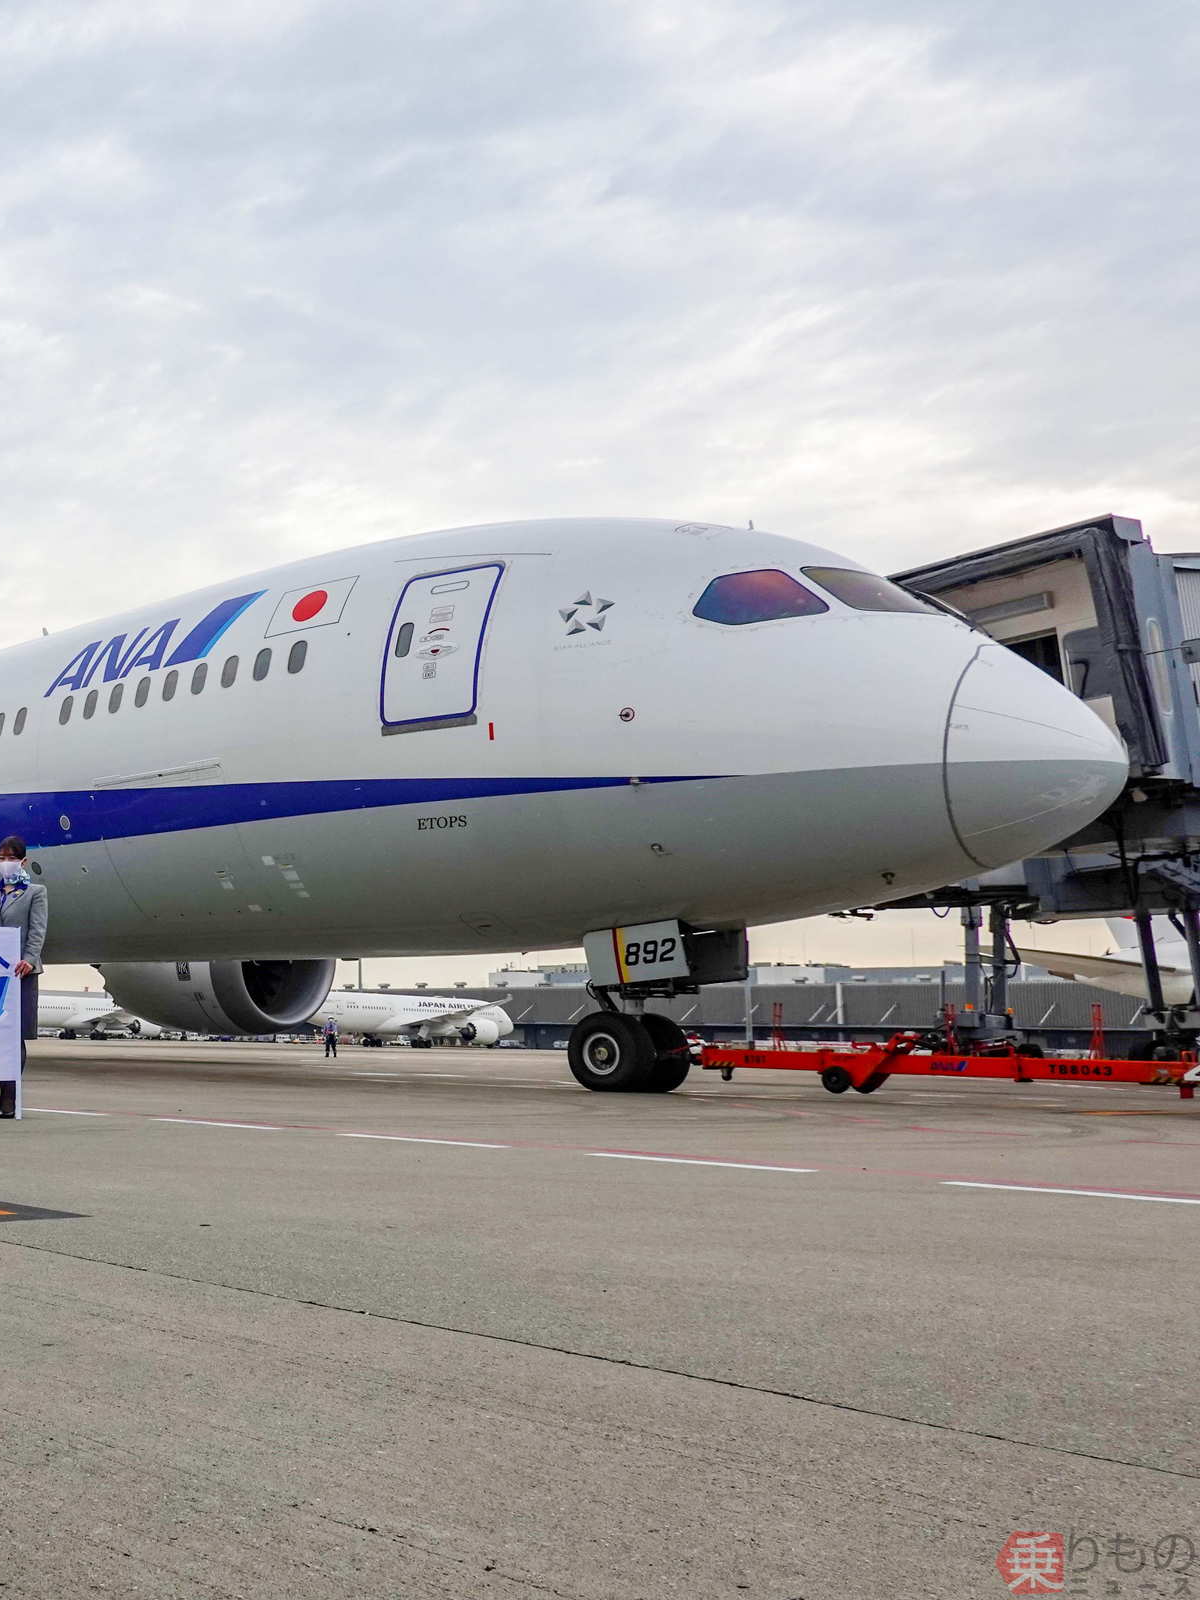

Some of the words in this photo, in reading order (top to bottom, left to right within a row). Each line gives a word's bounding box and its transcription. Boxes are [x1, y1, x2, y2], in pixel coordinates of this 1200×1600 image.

[44, 618, 181, 698] ANA
[417, 815, 468, 831] ETOPS
[625, 937, 677, 966] 892
[418, 1000, 446, 1009] JAPAN
